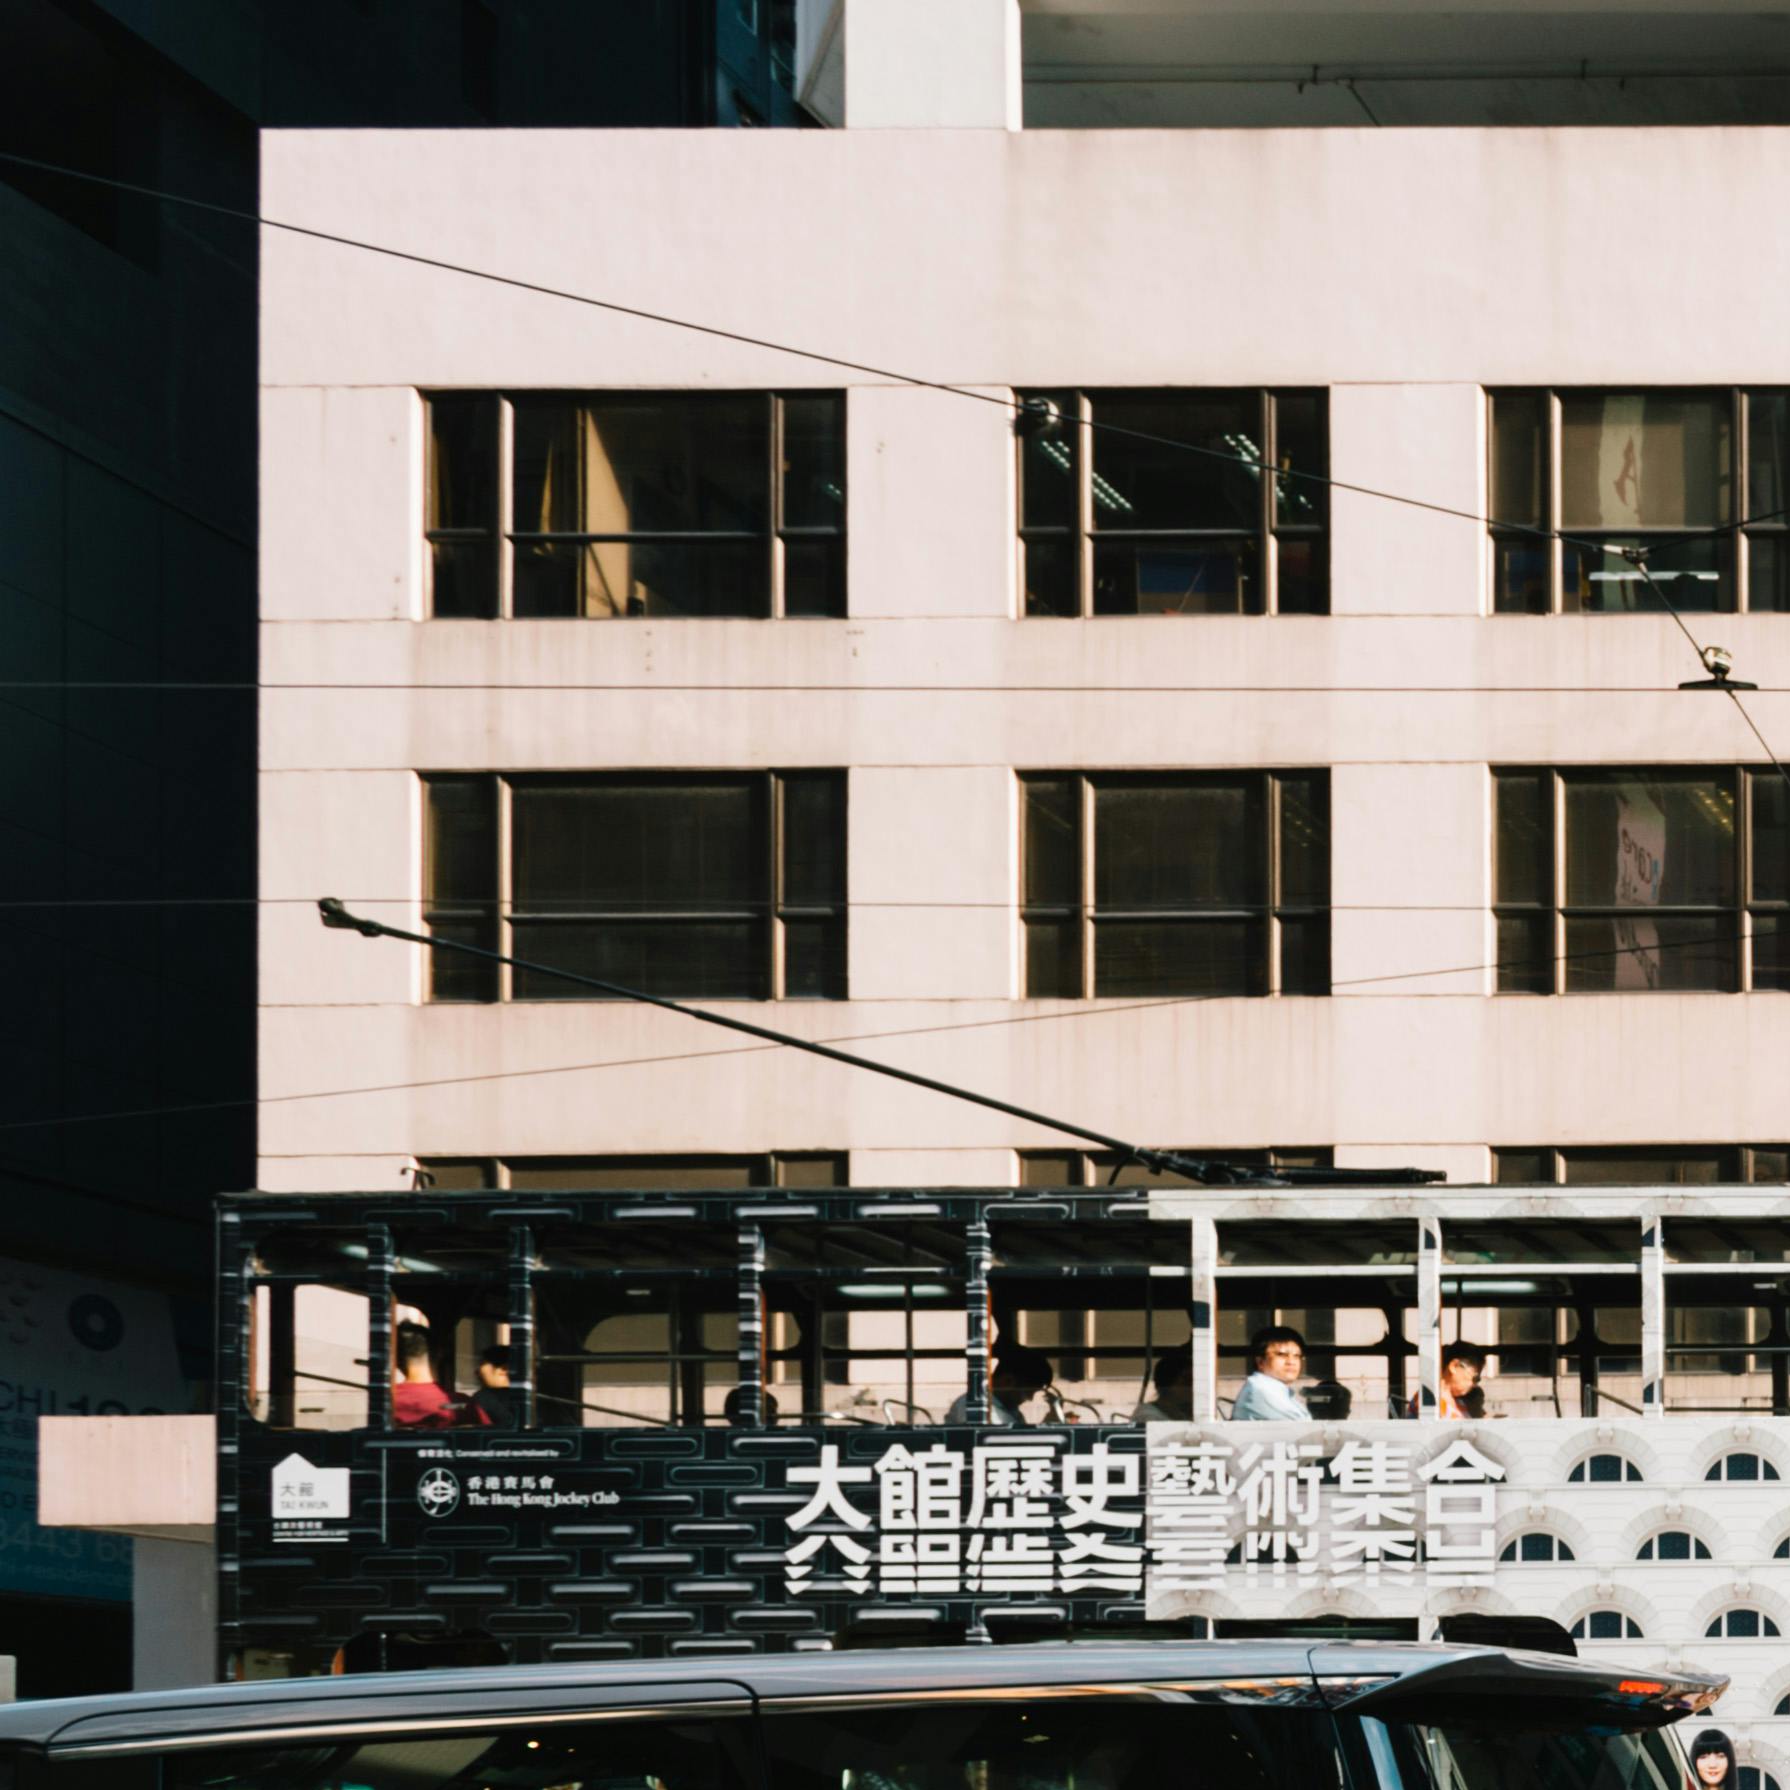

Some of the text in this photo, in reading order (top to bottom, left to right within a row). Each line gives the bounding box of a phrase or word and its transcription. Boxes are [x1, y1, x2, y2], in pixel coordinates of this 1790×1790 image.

[468, 1491, 620, 1507] The Hong Kong Jockey Club
